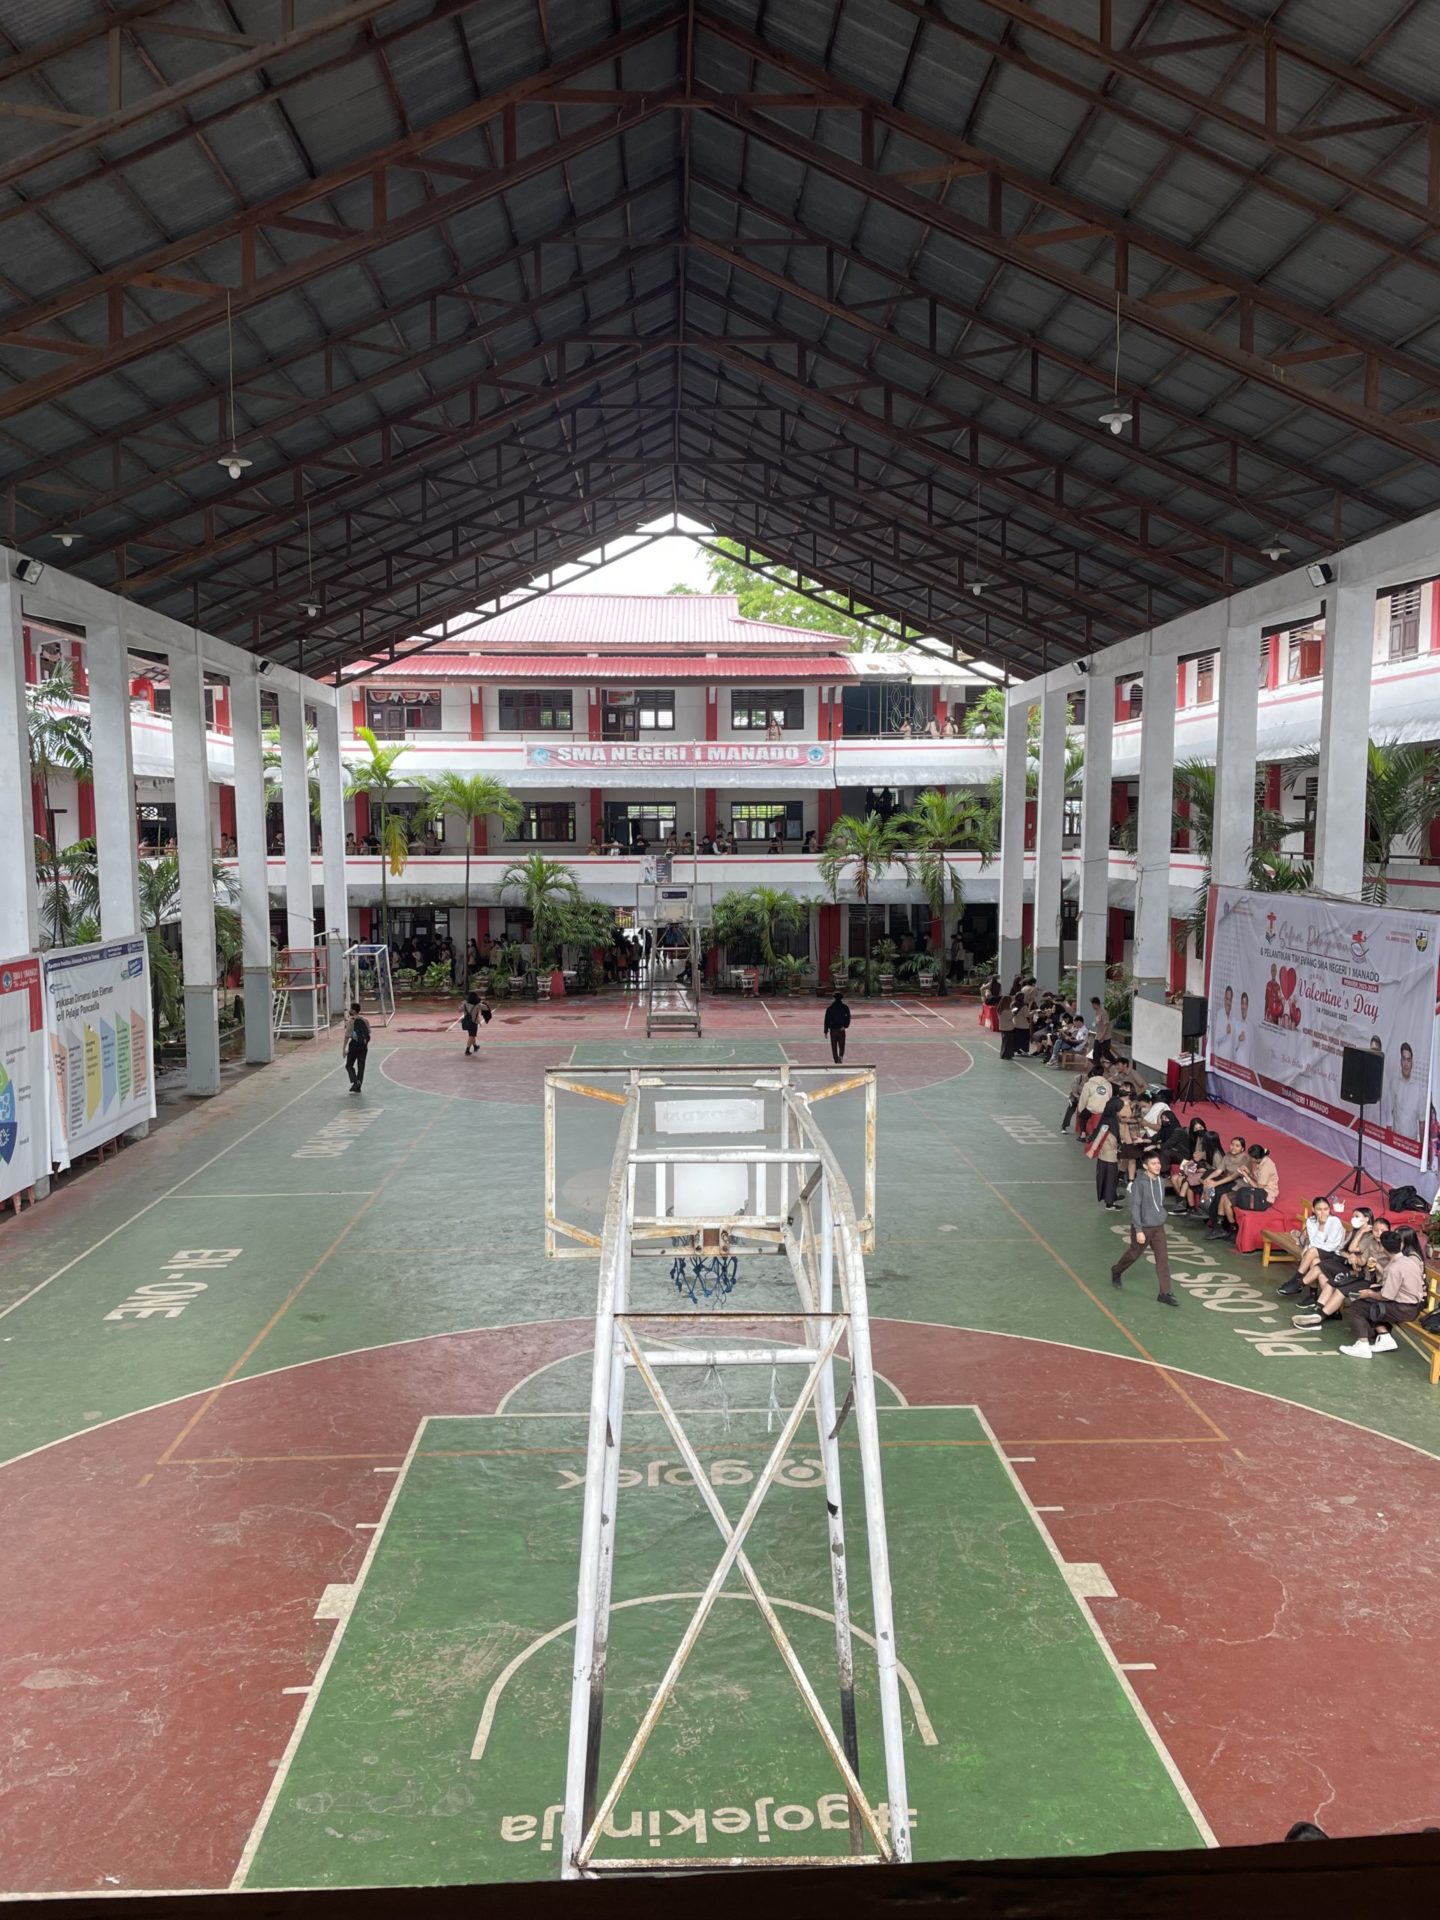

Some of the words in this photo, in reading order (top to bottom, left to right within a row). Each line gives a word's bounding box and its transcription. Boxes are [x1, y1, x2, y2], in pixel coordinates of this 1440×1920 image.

[557, 747, 606, 761] SMA
[611, 747, 686, 761] NEGERI
[694, 747, 702, 760] 1
[707, 747, 800, 761] MANADO
[1264, 947, 1291, 963] PELANTIKAN
[1317, 957, 1328, 970] SMA
[1328, 961, 1347, 975] NEGERI
[1352, 968, 1380, 983] MANADO
[1299, 977, 1349, 1011] Valentine's
[1353, 993, 1380, 1024] Day
[555, 1458, 755, 1490] gojek
[501, 1793, 918, 1851] #gojekinja
